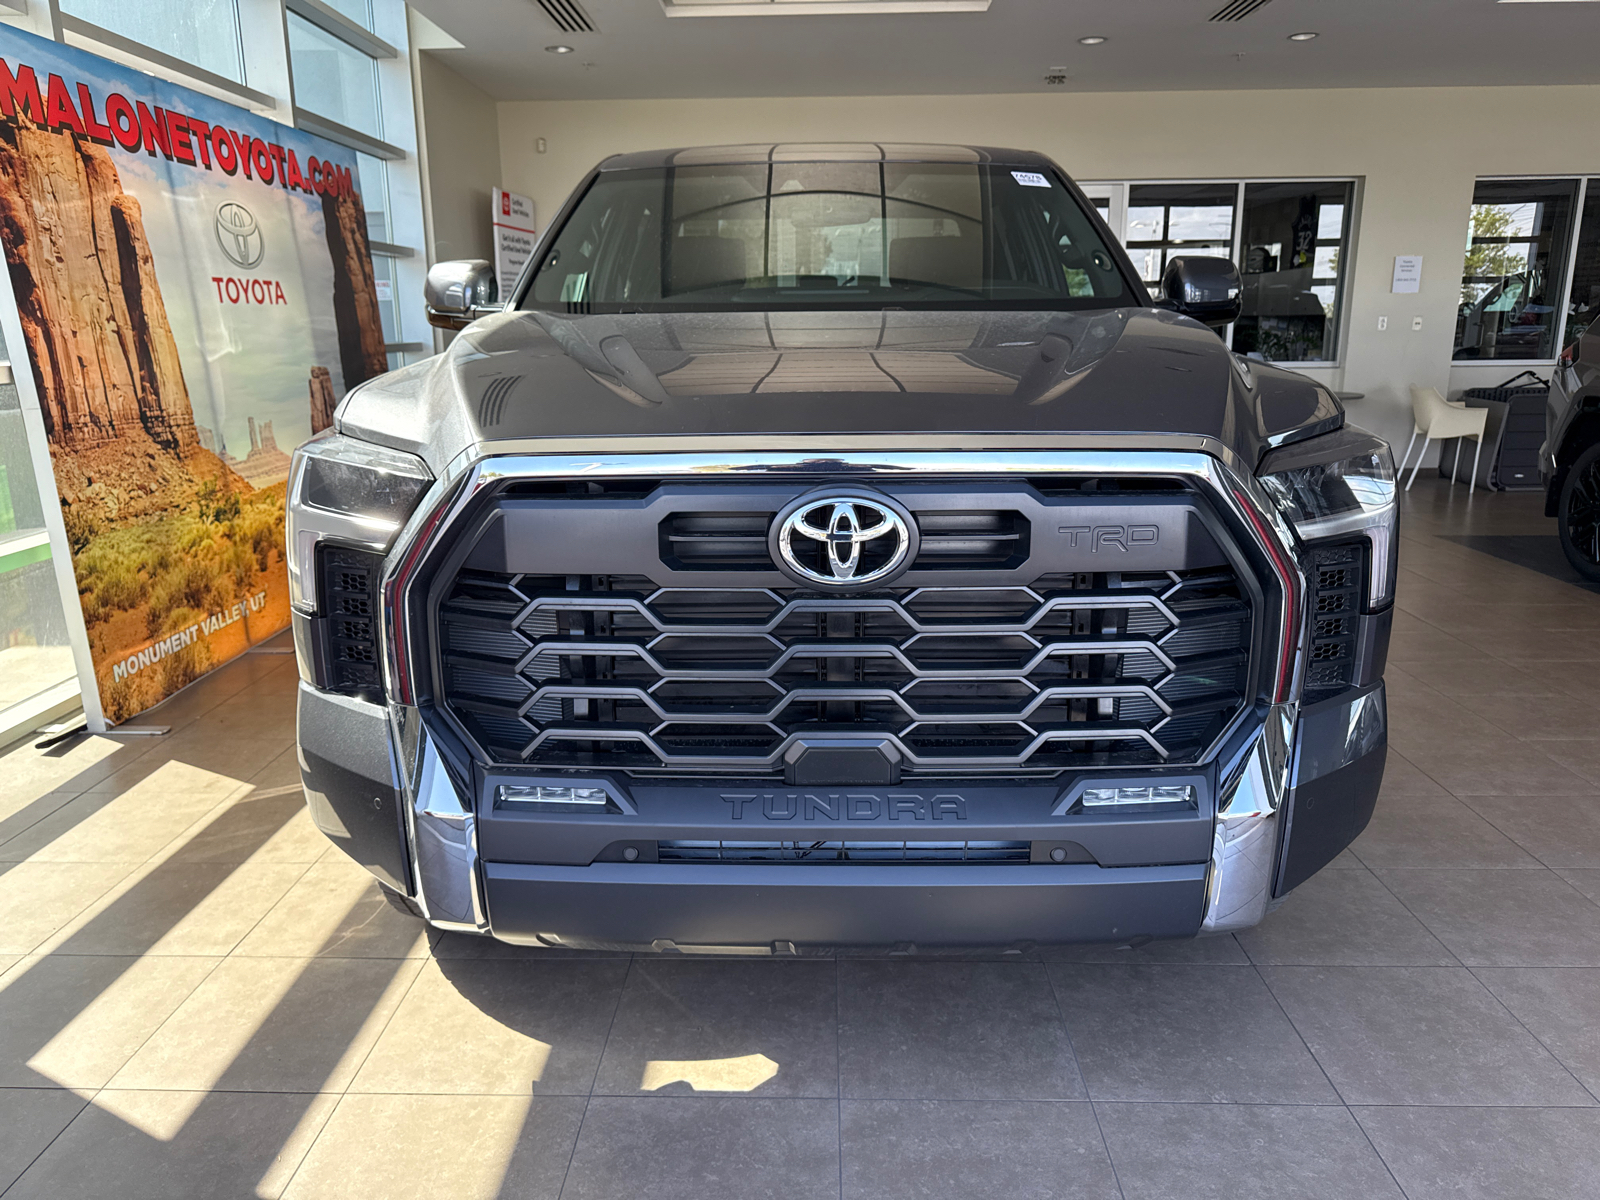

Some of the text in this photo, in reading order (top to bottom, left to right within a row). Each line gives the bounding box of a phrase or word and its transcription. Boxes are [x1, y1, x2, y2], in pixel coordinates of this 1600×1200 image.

[0, 57, 352, 199] MALONETOYOTA.COM
[1296, 230, 1312, 251] 32
[212, 276, 288, 305] TOYOTA
[1058, 524, 1160, 553] TRD
[112, 591, 267, 683] MONUMENT VALLEY, UT
[719, 794, 968, 821] TUNDRA
